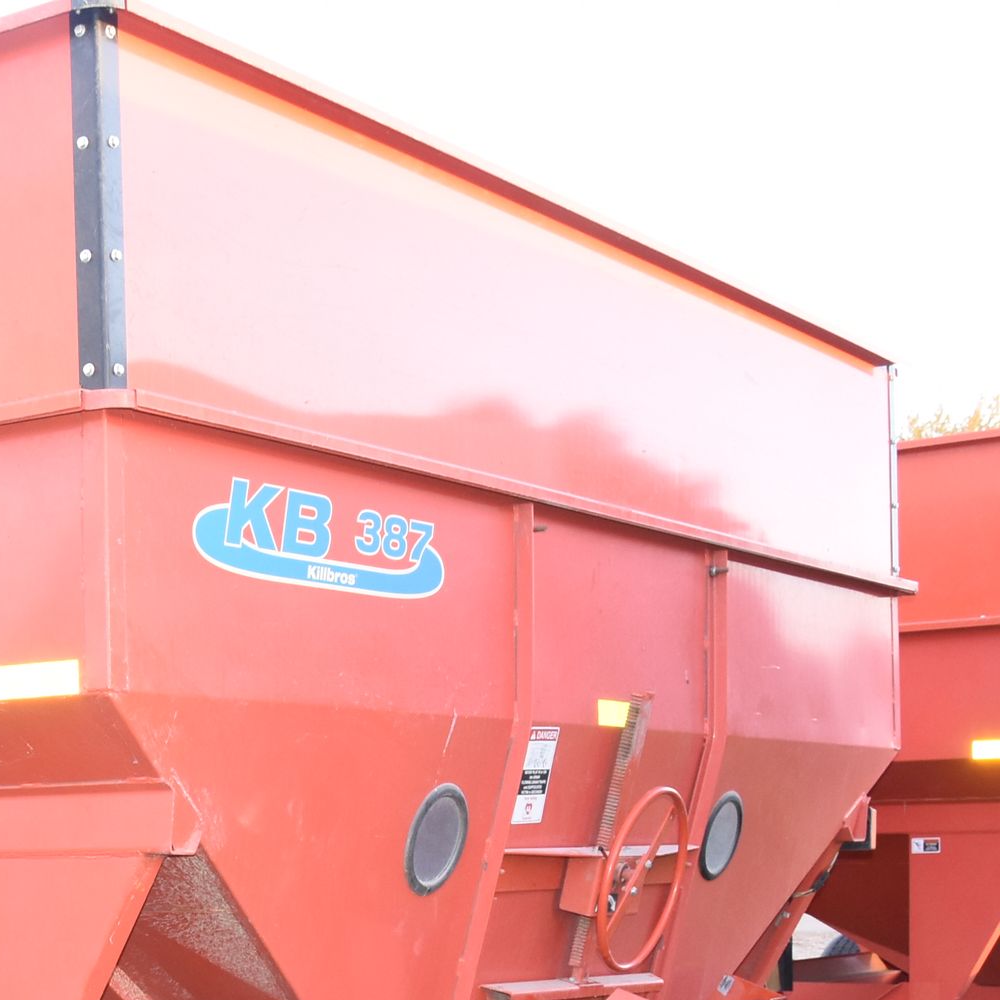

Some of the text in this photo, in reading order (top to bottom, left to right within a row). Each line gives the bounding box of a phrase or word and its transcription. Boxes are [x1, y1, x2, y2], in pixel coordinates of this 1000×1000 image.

[223, 476, 435, 564] KB 387
[306, 564, 356, 586] Killbros
